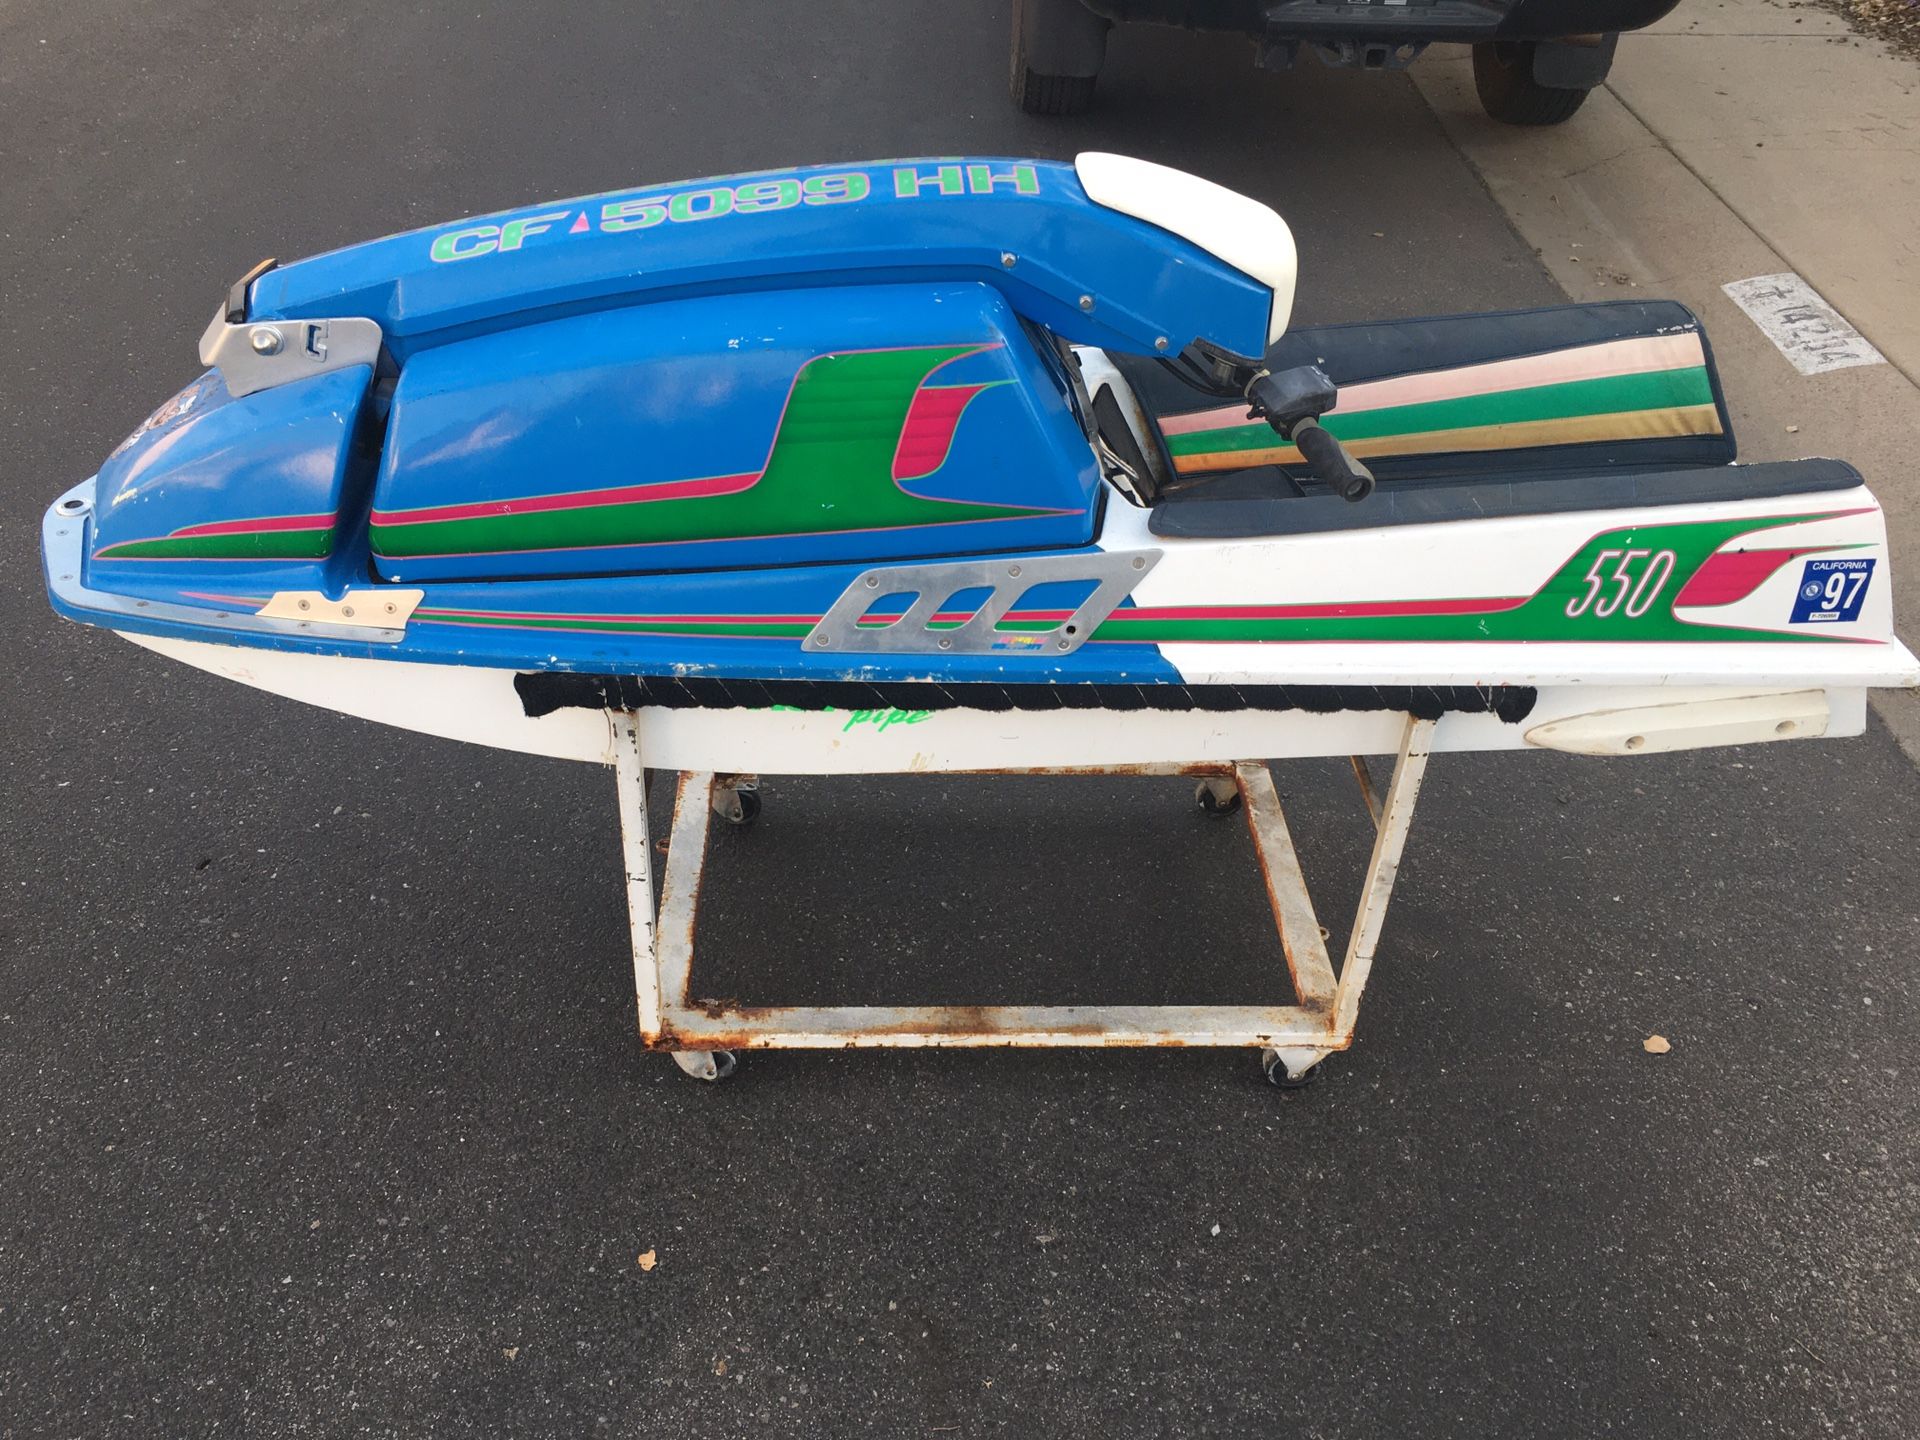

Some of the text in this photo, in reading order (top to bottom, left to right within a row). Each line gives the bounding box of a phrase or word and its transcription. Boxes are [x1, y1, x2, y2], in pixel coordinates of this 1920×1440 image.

[430, 165, 1041, 262] CF 5099 HH
[1564, 549, 1677, 619] 550
[1812, 561, 1868, 571] CALIFORNIA
[1820, 572, 1868, 610] 97
